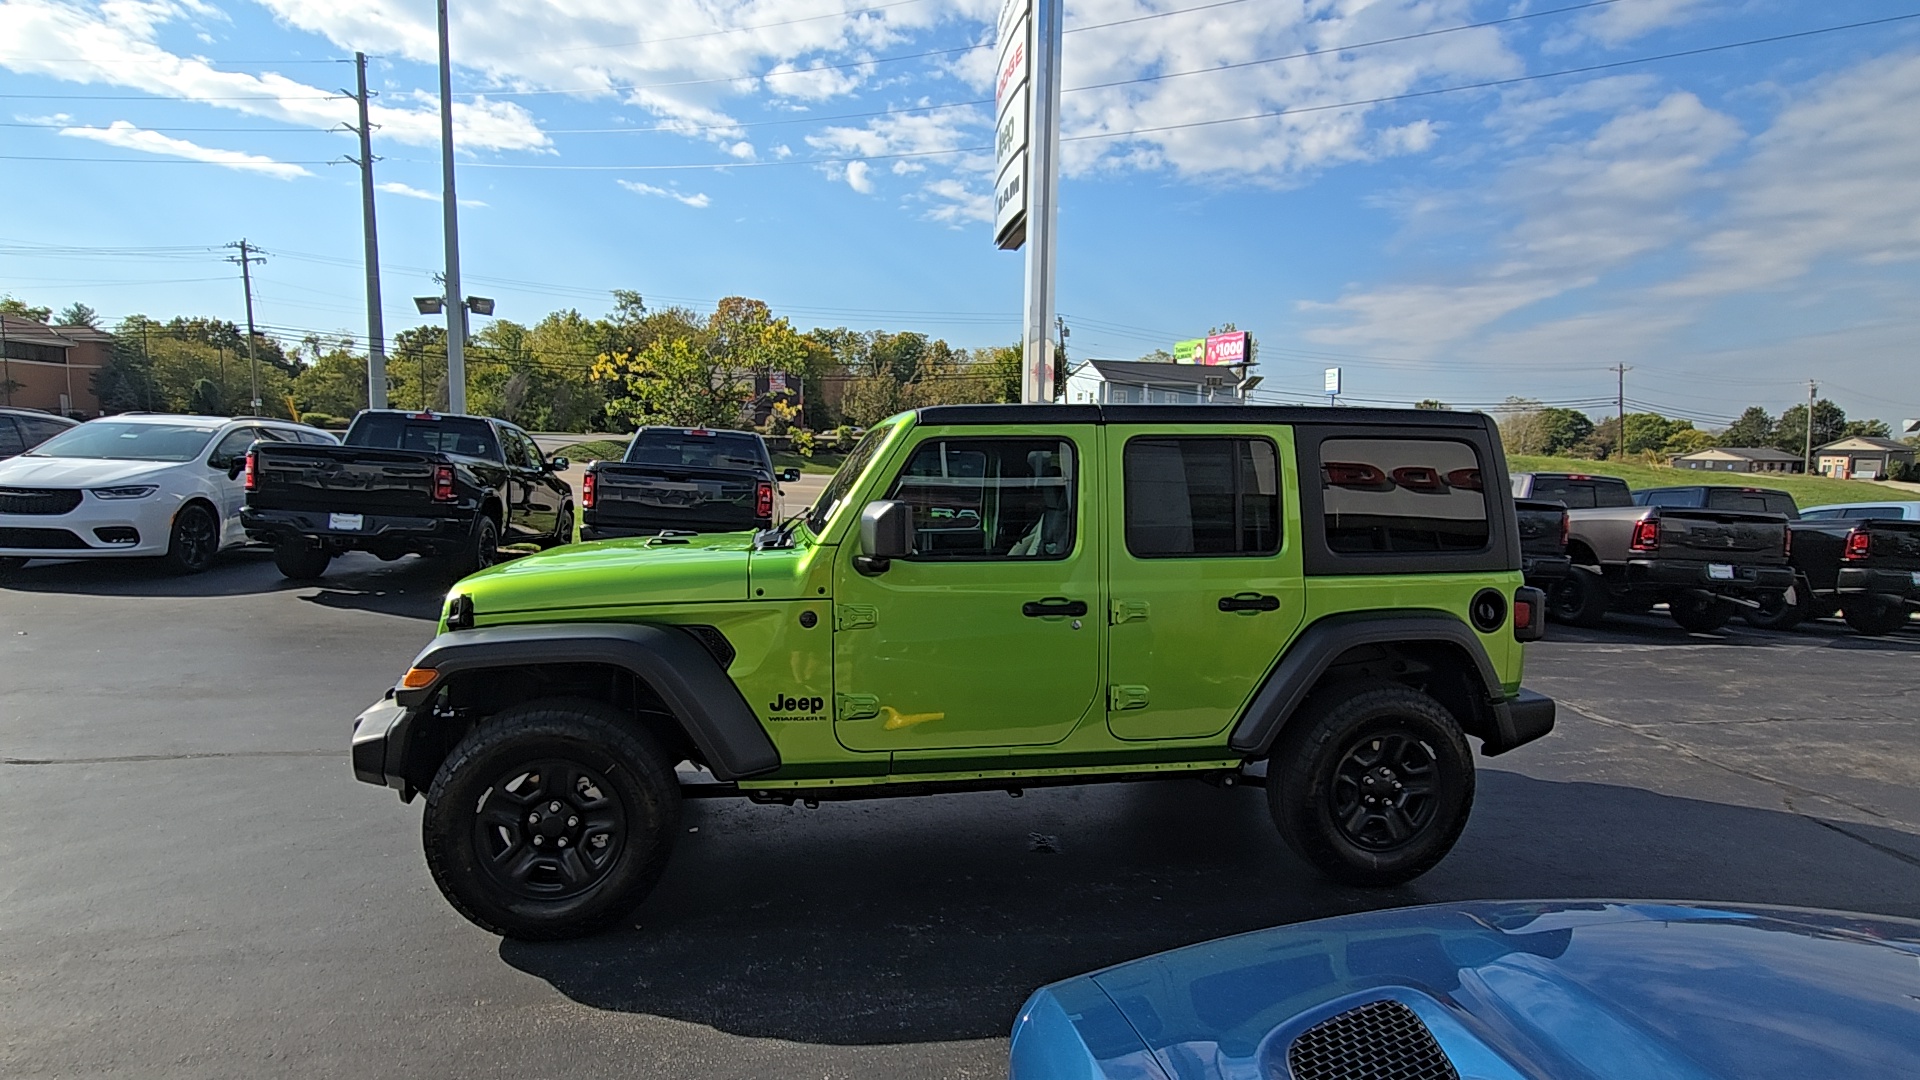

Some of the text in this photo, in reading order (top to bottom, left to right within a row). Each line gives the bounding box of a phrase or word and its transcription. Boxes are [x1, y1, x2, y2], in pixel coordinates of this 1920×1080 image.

[997, 116, 1015, 164] Jeep
[998, 174, 1020, 216] RAM
[1216, 341, 1243, 355] $1000
[931, 508, 980, 519] RA
[769, 693, 824, 714] Jeep
